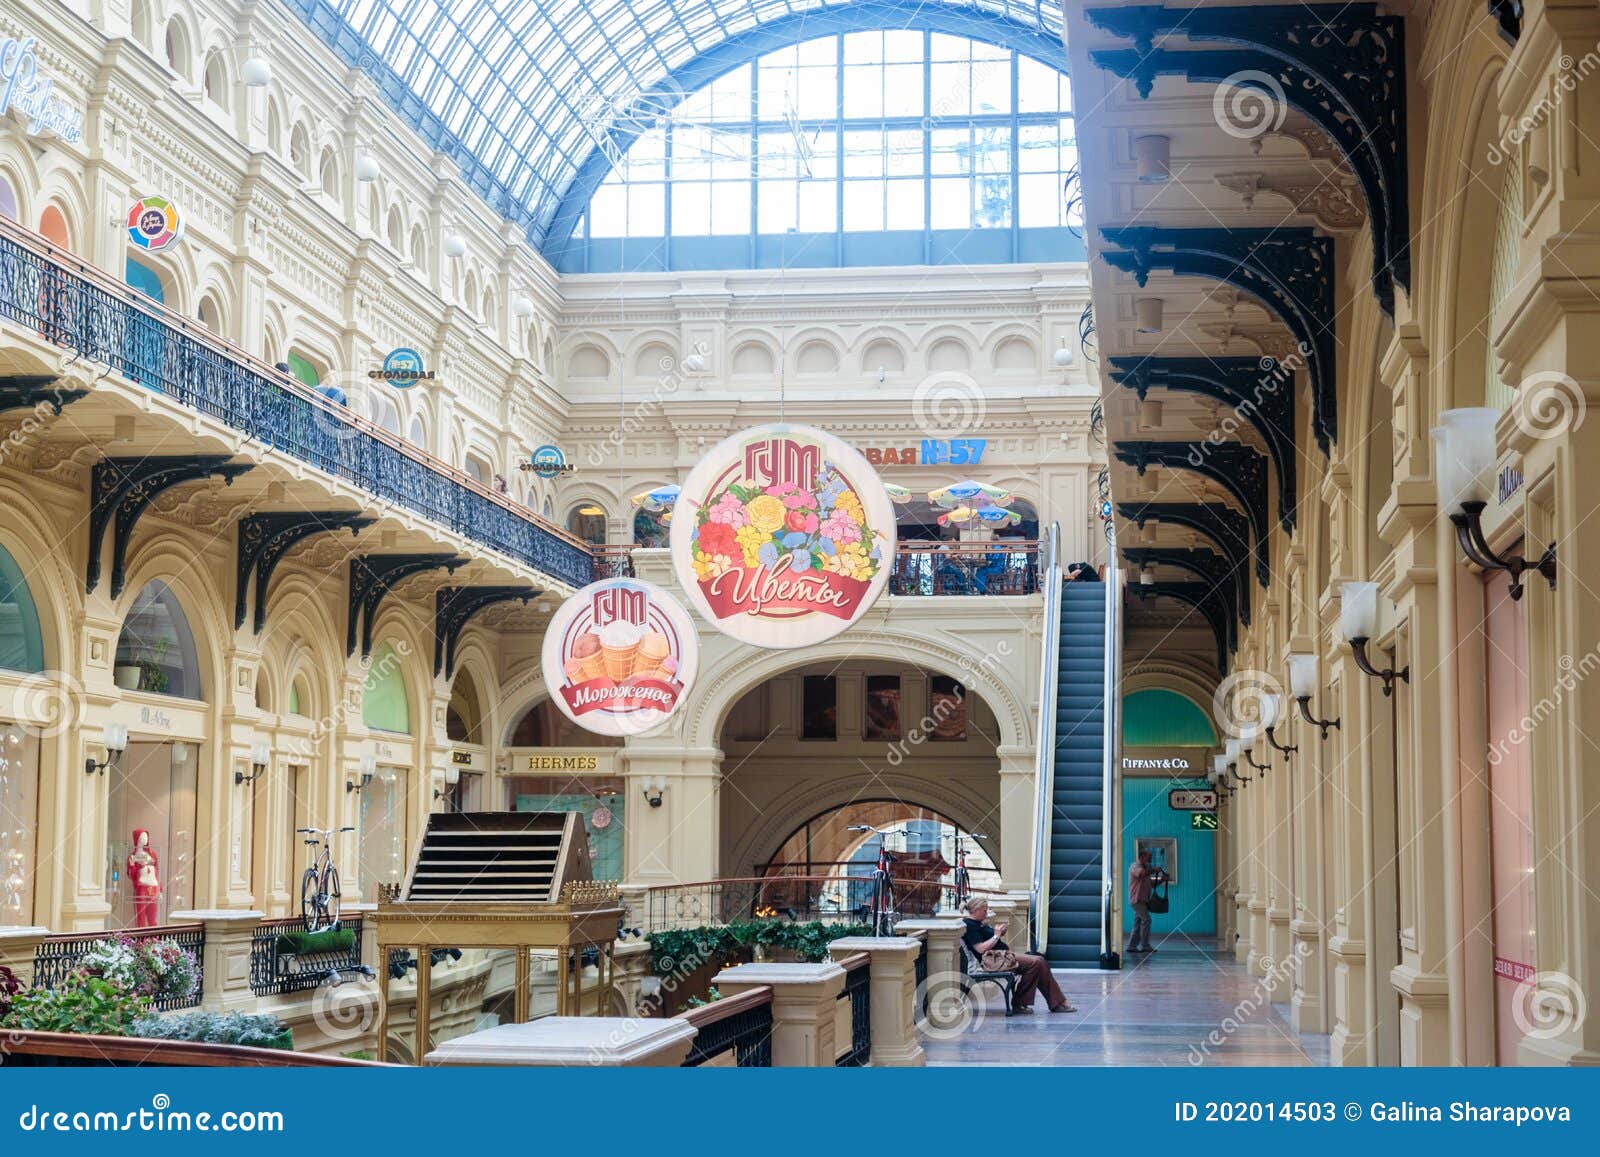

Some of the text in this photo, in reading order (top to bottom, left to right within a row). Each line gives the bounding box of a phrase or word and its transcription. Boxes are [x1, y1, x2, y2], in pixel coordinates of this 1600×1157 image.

[368, 370, 435, 379] СТОЛОВАЯ
[745, 439, 821, 492] ГУМ
[710, 553, 851, 616] Цветы
[593, 587, 647, 627] ГУМ
[572, 685, 673, 709] Мороженое
